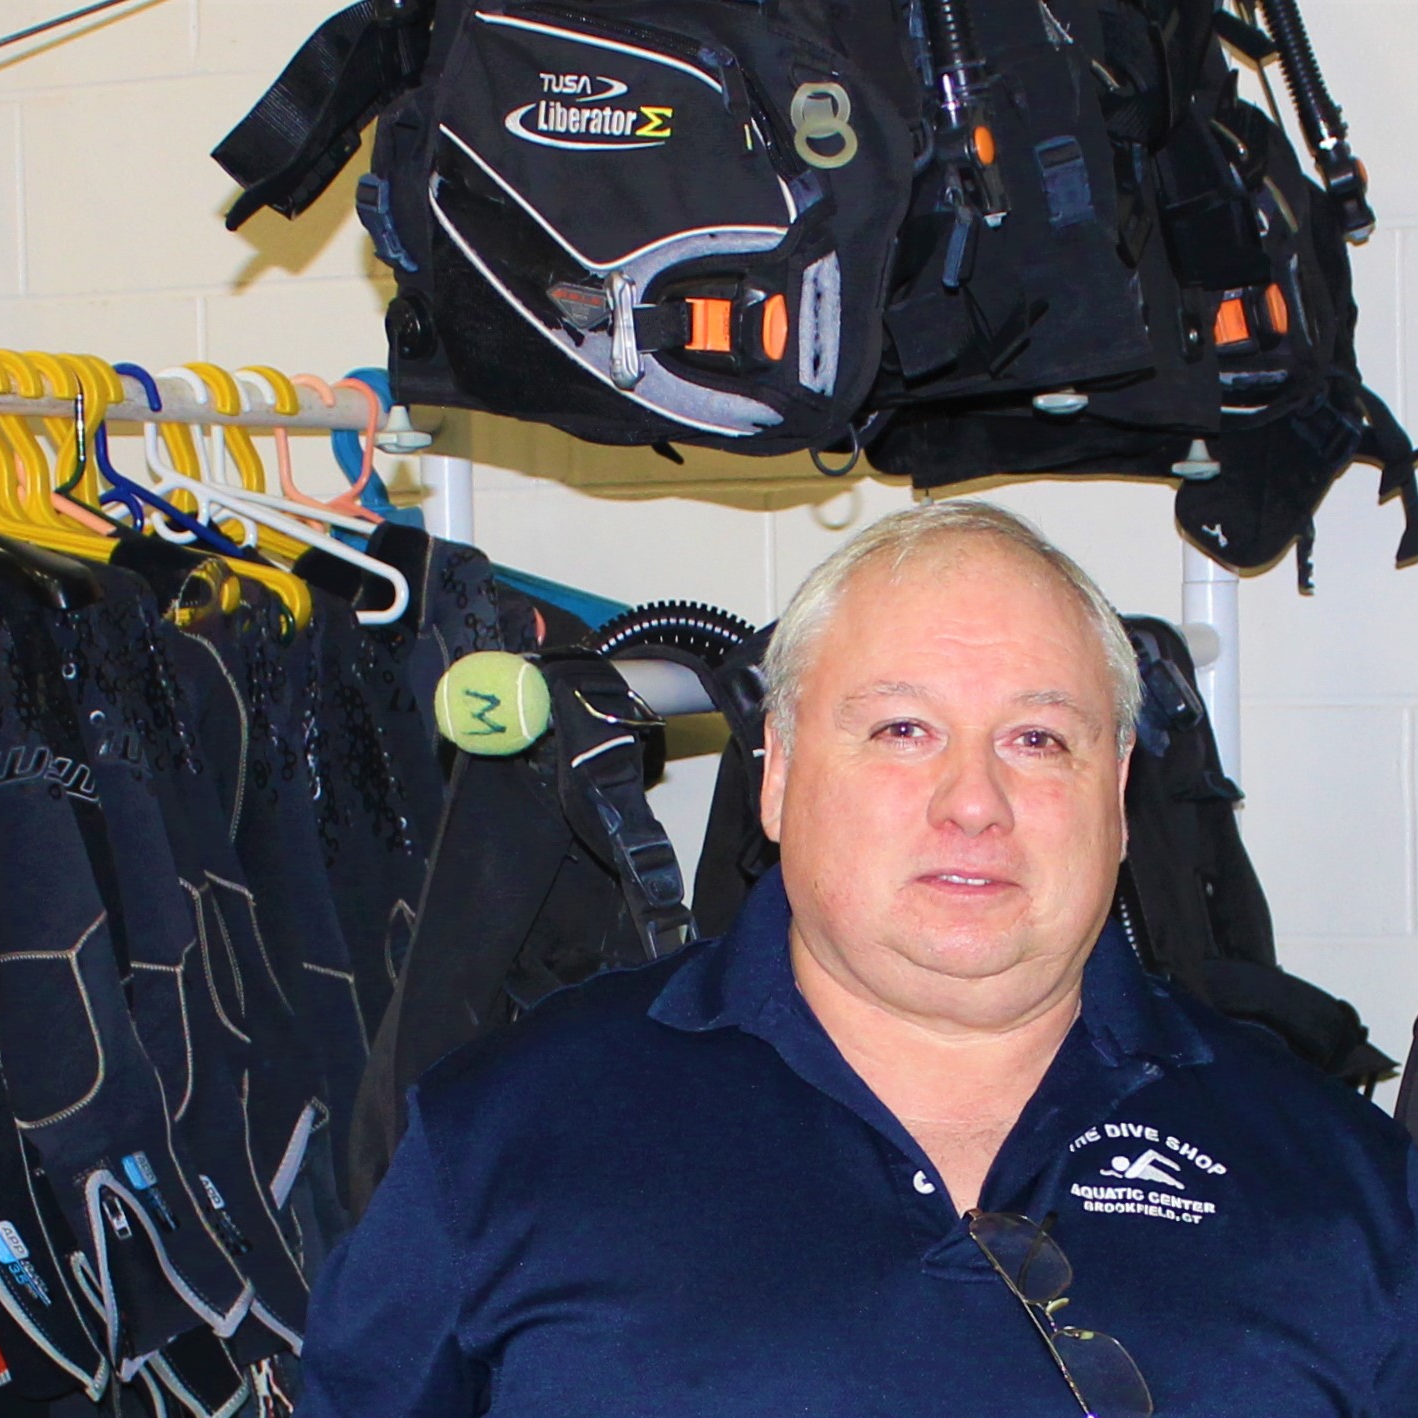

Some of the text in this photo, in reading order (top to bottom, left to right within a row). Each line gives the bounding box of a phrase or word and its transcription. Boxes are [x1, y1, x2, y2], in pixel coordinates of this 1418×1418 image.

[539, 72, 592, 95] TUSA
[1104, 1122, 1160, 1143] DIVE
[1165, 1136, 1228, 1176] SHOP
[1070, 1182, 1217, 1214] AQUATIC CENTER
[2, 1226, 26, 1255] APP
